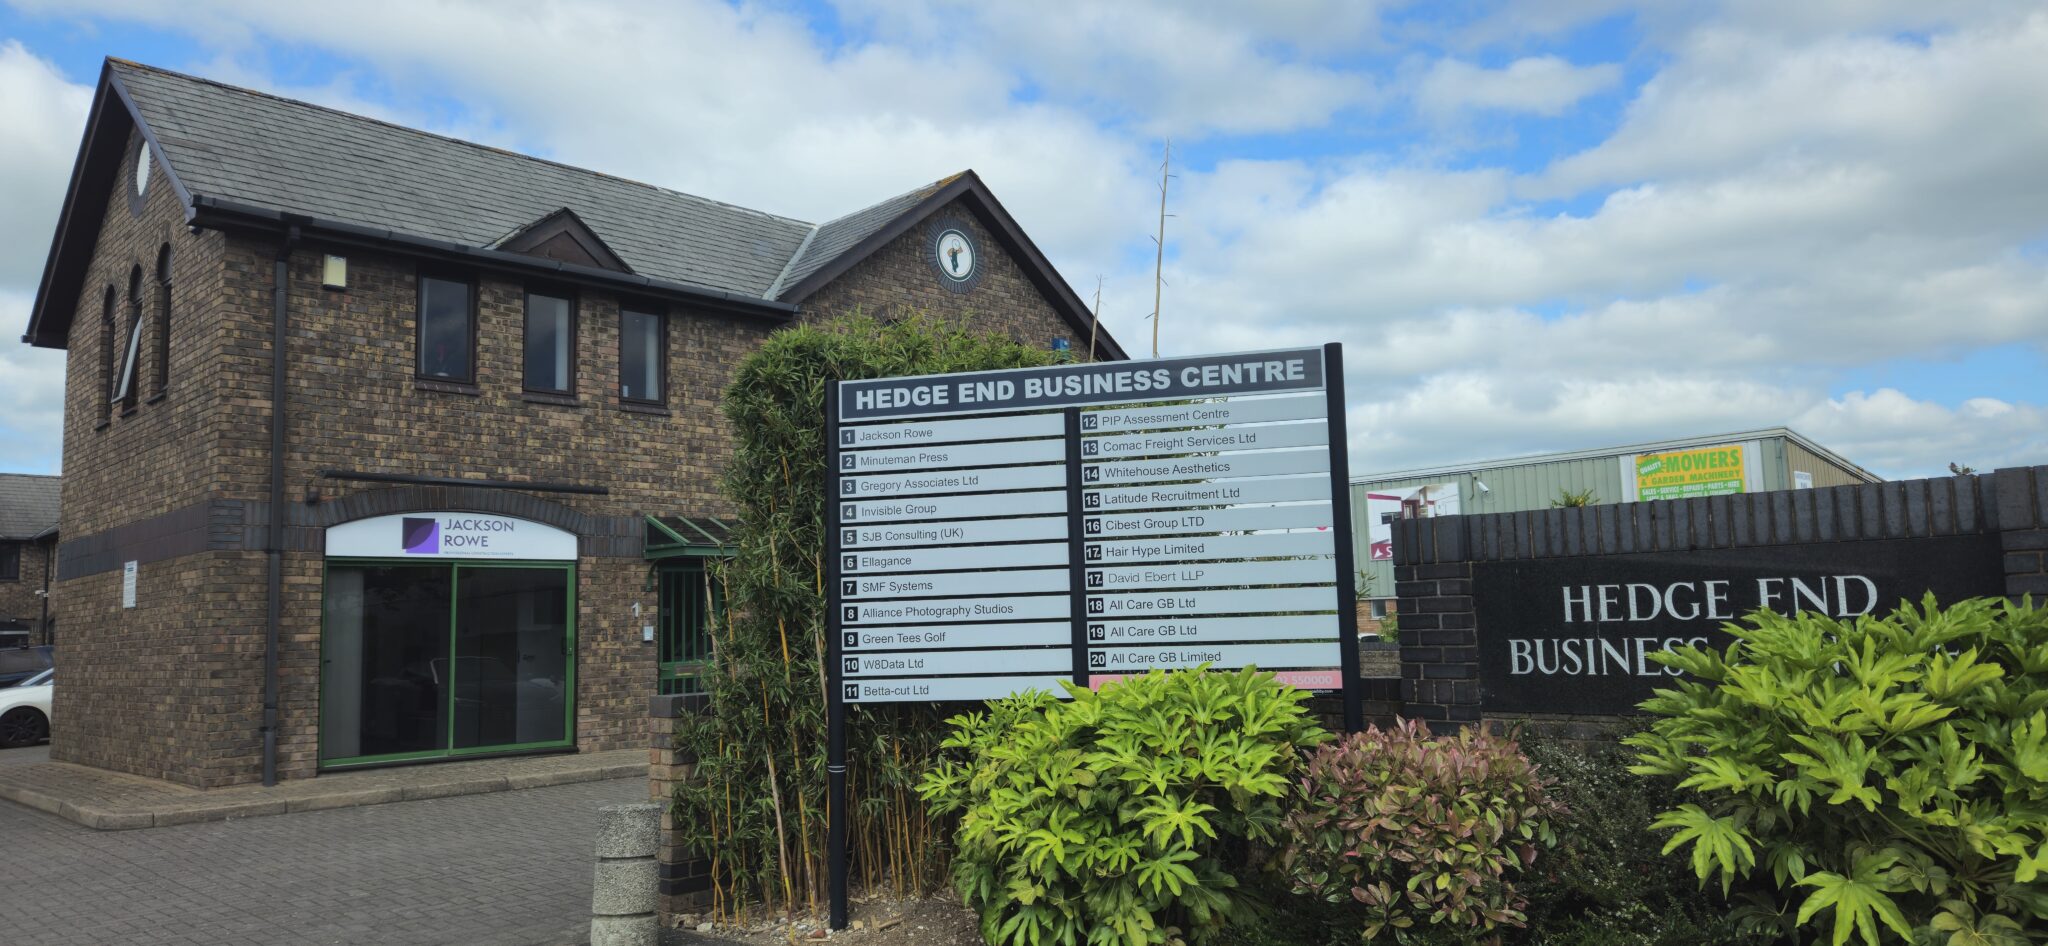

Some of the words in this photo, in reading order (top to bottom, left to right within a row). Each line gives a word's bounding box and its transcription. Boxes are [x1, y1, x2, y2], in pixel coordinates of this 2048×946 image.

[856, 385, 948, 410] HEDGE
[959, 381, 1014, 403] END
[1024, 369, 1171, 399] BUSINESS
[1180, 359, 1305, 388] CENTRE
[1084, 417, 1096, 427] 12
[1103, 416, 1121, 426] PIP
[1124, 412, 1189, 424] Assessment
[1193, 409, 1229, 420] Centre
[845, 431, 851, 441] 1
[860, 431, 900, 441] Jackson
[904, 429, 932, 438] Rowe
[1084, 443, 1097, 453] 13
[1104, 442, 1142, 451] Comac
[1146, 438, 1183, 450] Freight
[1187, 435, 1235, 446] Services
[1239, 433, 1256, 443] Ltd
[845, 456, 853, 466] 2
[861, 456, 915, 466] Minuteman
[919, 453, 948, 462] Press
[1666, 450, 1740, 473] MOWERS
[1084, 469, 1098, 479] 14
[1105, 467, 1169, 478] Whitehouse
[1172, 463, 1230, 474] Aesthetics
[1651, 476, 1684, 484] GARDEN
[1690, 470, 1740, 481] MACHINERY
[845, 482, 853, 491] 3
[861, 482, 901, 492] Gregory
[905, 478, 959, 488] Associates
[963, 476, 978, 485] Ltd
[1086, 495, 1099, 505] 15
[1105, 493, 1147, 504] Latitude
[1152, 489, 1219, 501] Recruitment
[1223, 488, 1239, 498] Ltd
[845, 507, 853, 517] 4
[862, 506, 902, 516] Invisible
[906, 504, 936, 515] Group
[445, 519, 514, 531] JACKSON
[1087, 521, 1099, 531] 16
[1106, 520, 1140, 530] Cibest
[1144, 519, 1178, 529] Group
[1182, 517, 1204, 527] LTD
[445, 535, 488, 547] ROWE
[846, 532, 854, 542] 5
[862, 532, 882, 541] SJB
[885, 530, 937, 540] Consulting
[941, 528, 963, 539] (UK)
[1107, 547, 1128, 557] Hair
[1132, 546, 1160, 558] Hype
[1165, 543, 1204, 554] Limited
[846, 557, 854, 567] 6
[862, 557, 911, 568] Ellagance
[1109, 573, 1139, 583] David
[1145, 572, 1176, 582] Ebert
[1182, 571, 1204, 580] LLP
[846, 583, 854, 593] 7
[863, 582, 885, 592] SMF
[889, 582, 933, 593] Systems
[1090, 601, 1102, 610] 18
[1110, 600, 1123, 610] All
[1127, 600, 1153, 609] Care
[1157, 599, 1174, 608] GB
[1179, 598, 1195, 608] Ltd
[1562, 580, 1734, 623] HEDGE
[1757, 575, 1878, 617] END
[631, 601, 640, 617] 1
[847, 608, 855, 619] 8
[863, 609, 902, 617] Alliance
[906, 605, 971, 618] Photography
[975, 604, 1013, 614] Studios
[1091, 628, 1103, 637] 19
[1111, 627, 1124, 637] All
[1128, 627, 1154, 636] Care
[1159, 626, 1176, 635] GB
[1180, 625, 1197, 635] Ltd
[847, 634, 855, 644] 9
[863, 634, 893, 643] Green
[897, 633, 921, 643] Tees
[924, 632, 945, 642] Golf
[846, 660, 857, 670] 10
[864, 660, 904, 669] W8Data
[908, 659, 923, 668] Ltd
[1092, 654, 1105, 664] 20
[1111, 654, 1124, 663] All
[1129, 653, 1155, 663] Care
[1159, 653, 1176, 662] GB
[1181, 652, 1221, 662] Limited
[847, 687, 857, 696] 11
[864, 687, 910, 696] Betta-cut
[914, 685, 928, 695] Ltd
